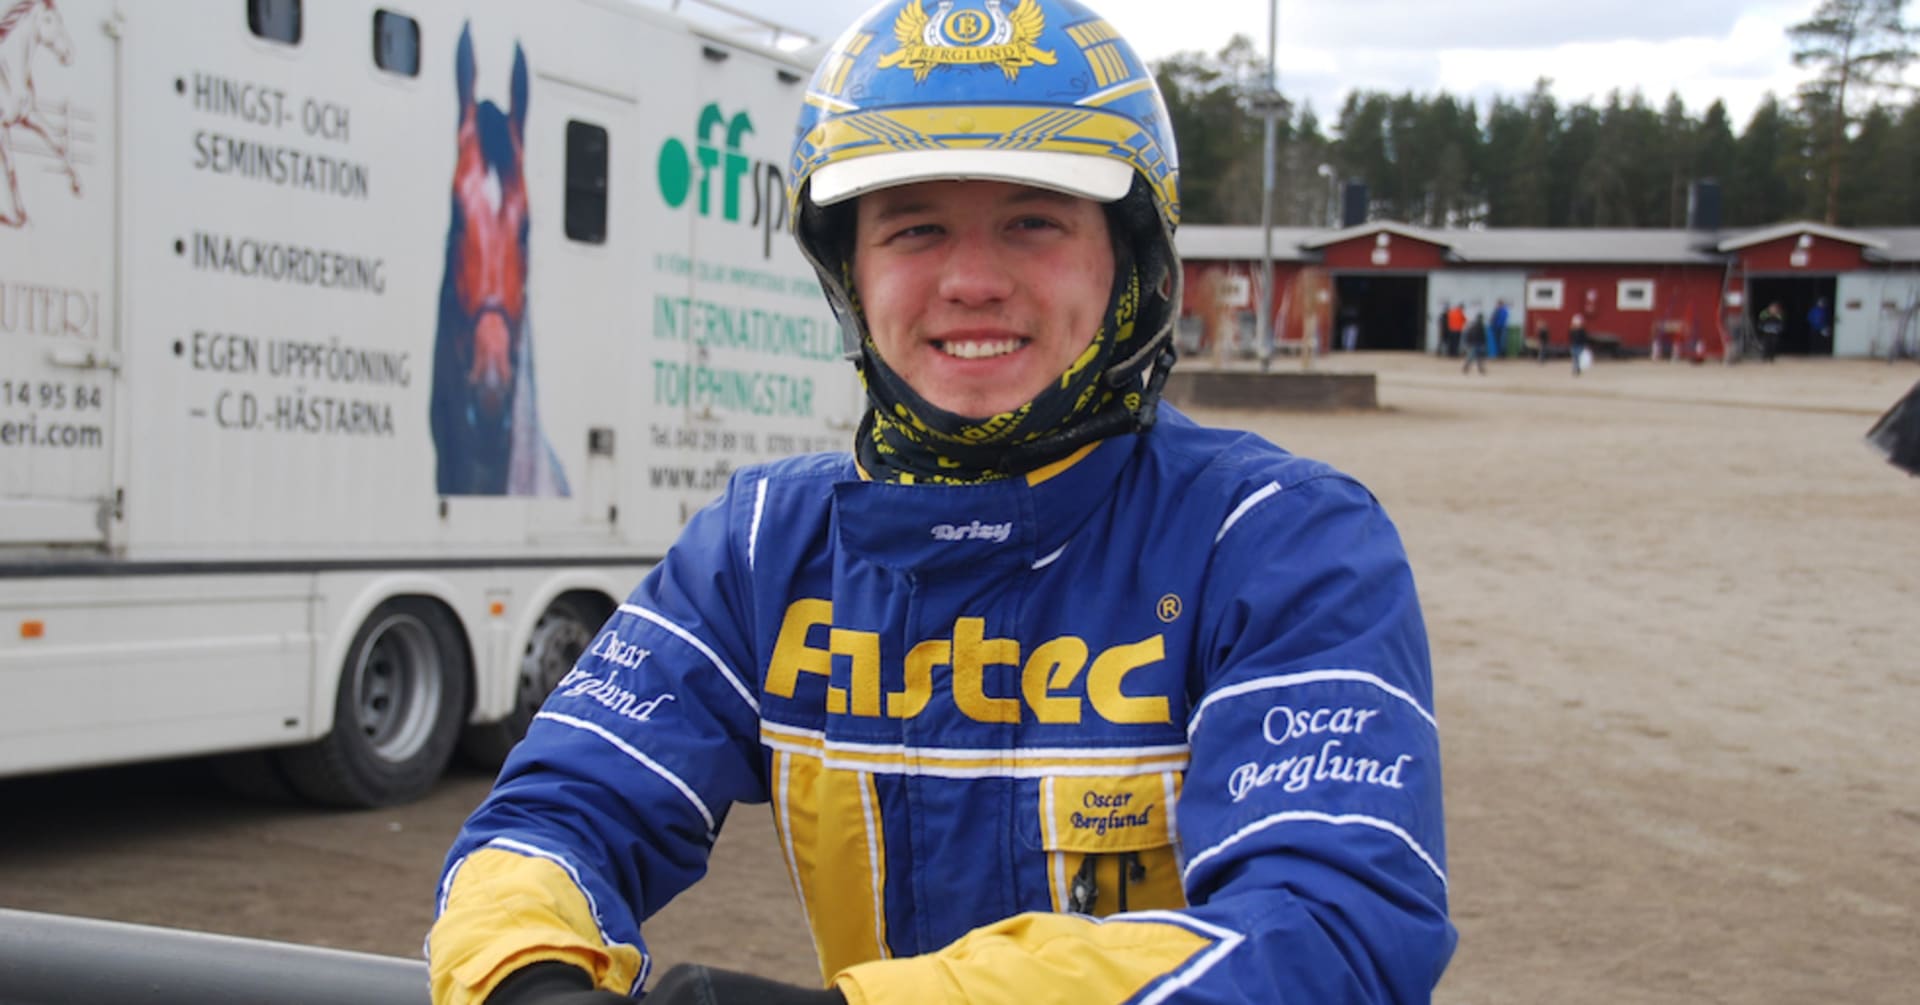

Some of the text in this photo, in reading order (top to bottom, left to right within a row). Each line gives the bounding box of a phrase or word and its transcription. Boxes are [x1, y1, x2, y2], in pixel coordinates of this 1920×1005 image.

[919, 47, 1017, 61] BERGLUND
[193, 73, 350, 144] HINGST- OCH
[194, 131, 369, 200] SEMINSTATION
[192, 231, 386, 296] INACKORDERING
[653, 294, 844, 361] INTERNATIONELLA
[192, 330, 411, 389] EGEN UPPFÖDNING
[4, 380, 30, 406] 14
[39, 382, 65, 411] 95
[215, 386, 395, 437] C.D.-HÄSTARNA
[653, 360, 815, 416] TOPPHINGSTAR
[0, 412, 102, 448] eri.com
[764, 598, 1174, 724] Fastec
[1262, 705, 1379, 745] Oscar
[1082, 790, 1134, 809] Oscar
[1228, 740, 1414, 803] Berglund
[1069, 804, 1155, 836] Berglund
